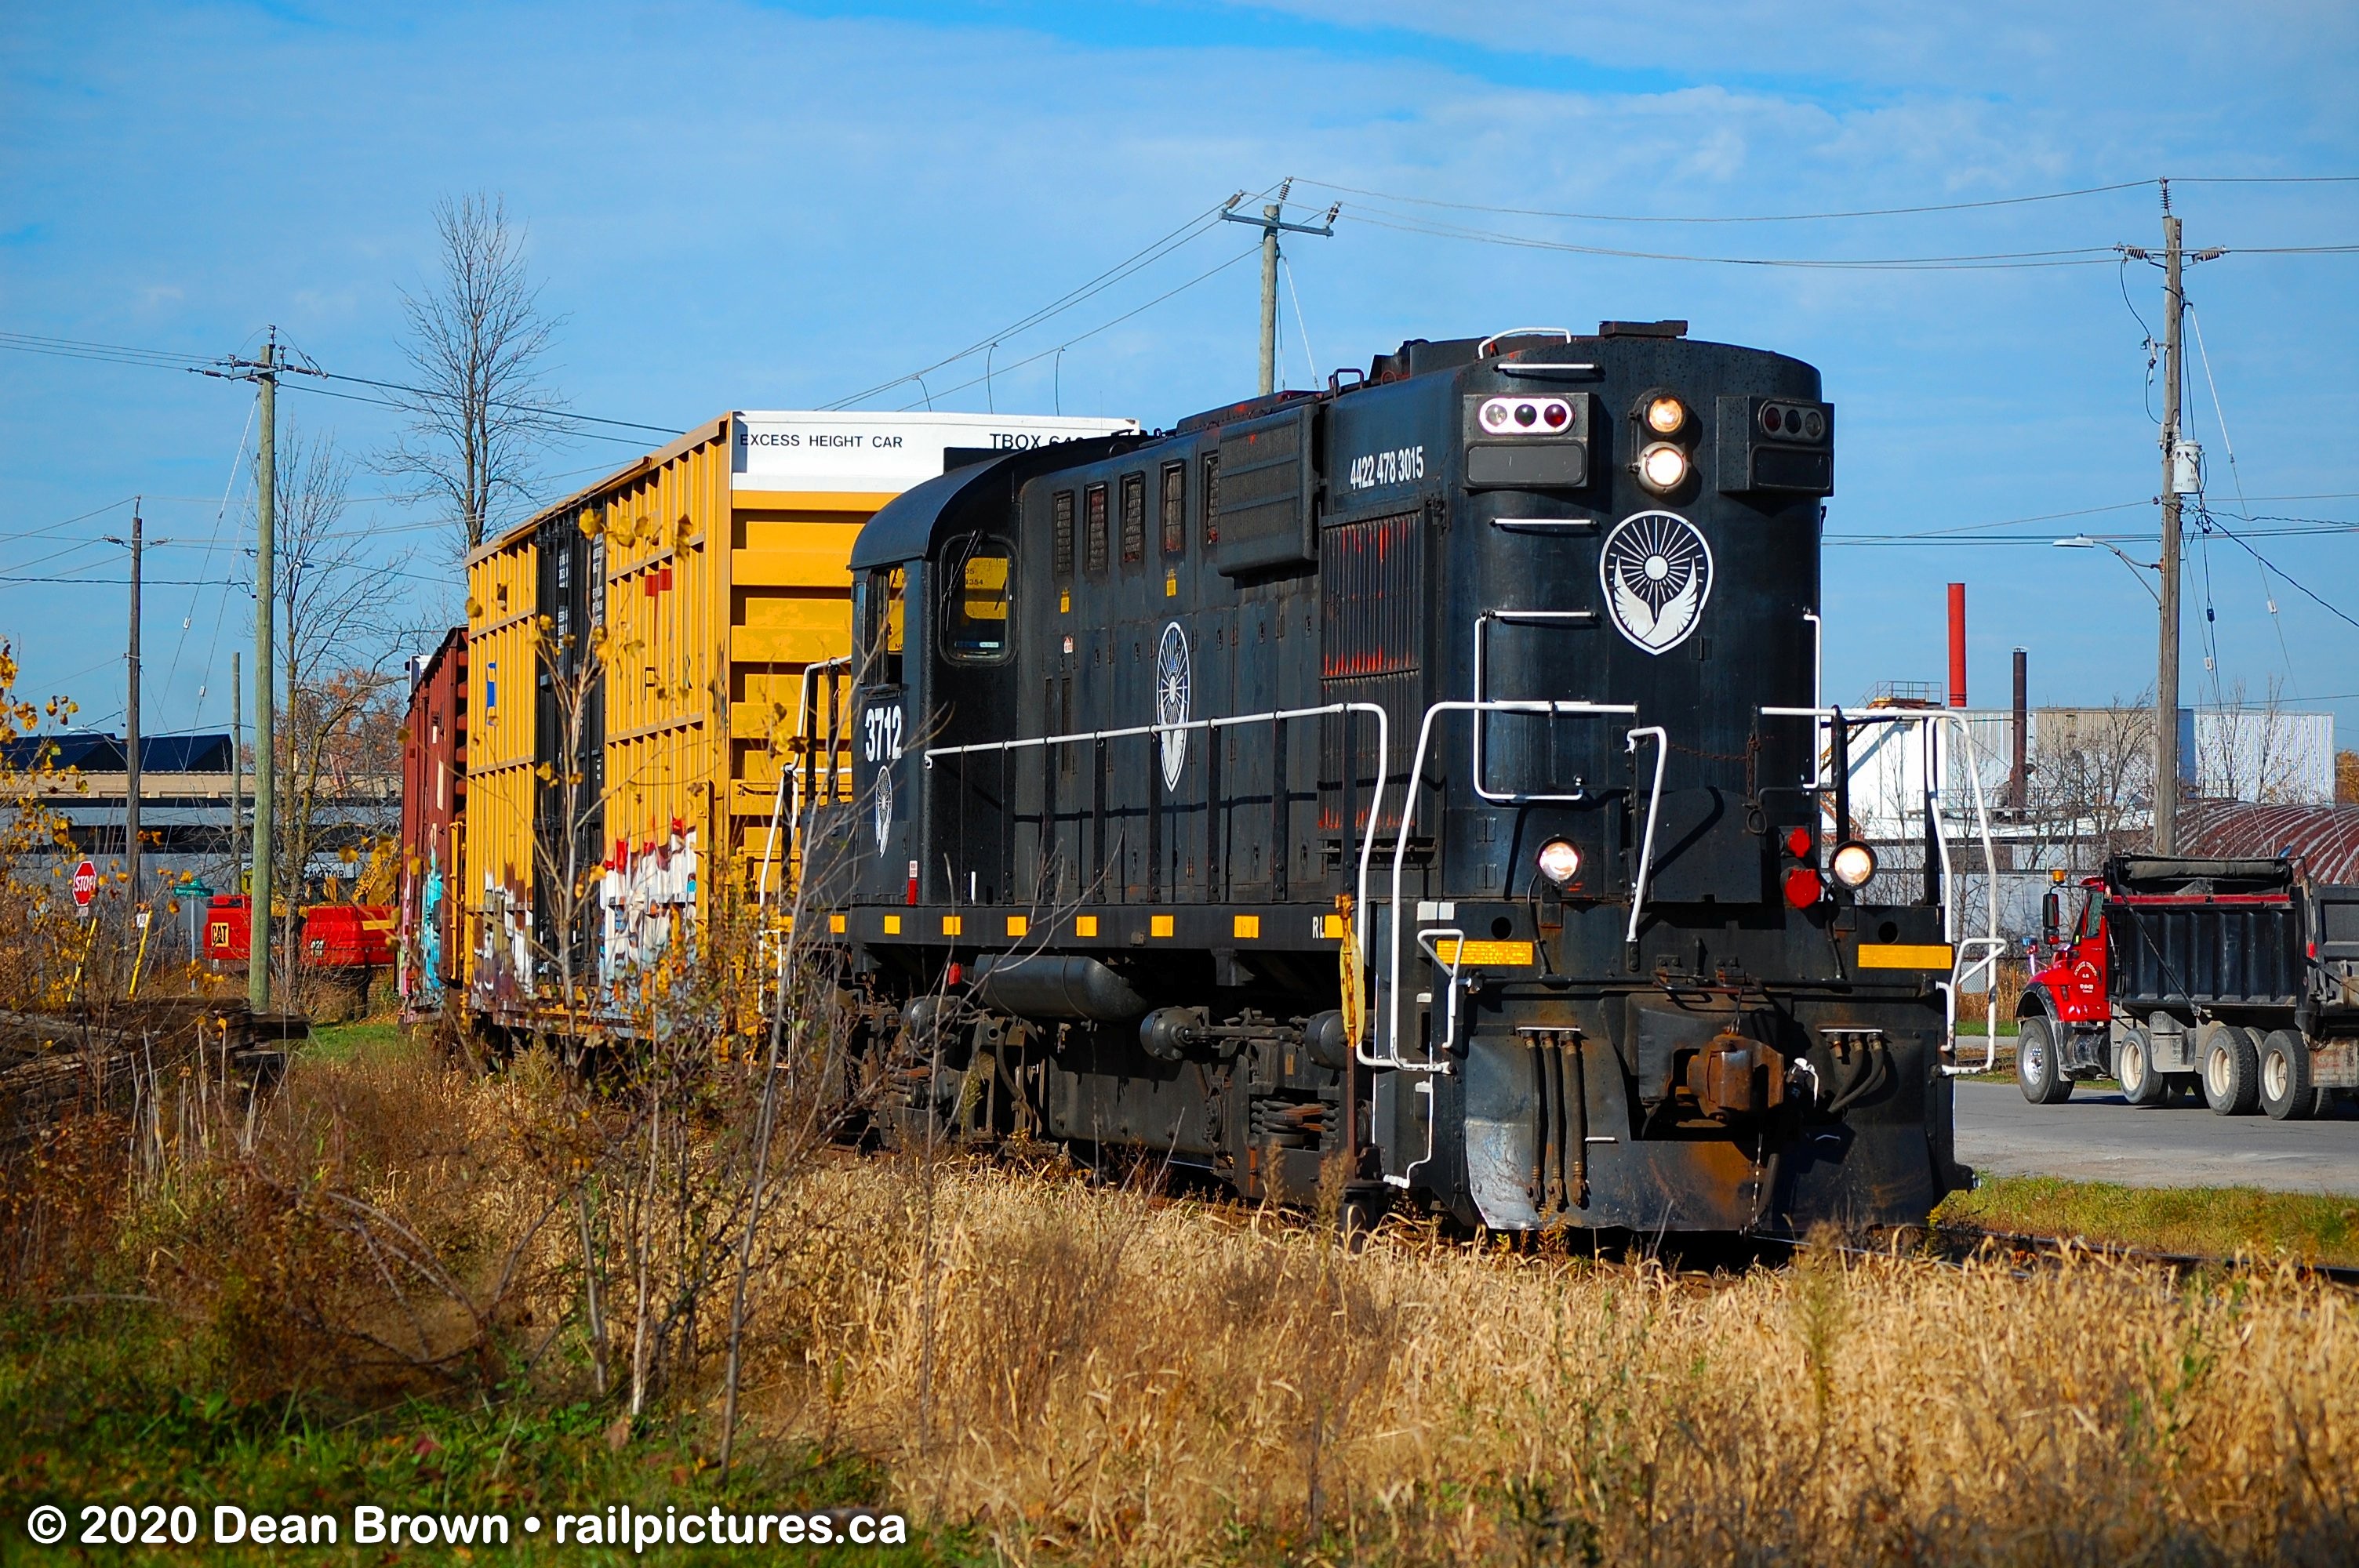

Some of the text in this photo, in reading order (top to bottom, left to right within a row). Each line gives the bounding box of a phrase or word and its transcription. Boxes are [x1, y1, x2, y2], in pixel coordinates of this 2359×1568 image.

[740, 434, 903, 448] EXCESS HEIGHT CAR
[989, 434, 1041, 450] TBOX
[1350, 445, 1423, 490] 4422 478 3015
[864, 705, 902, 762] 3712
[75, 875, 94, 892] STOP
[212, 925, 227, 943] CAT
